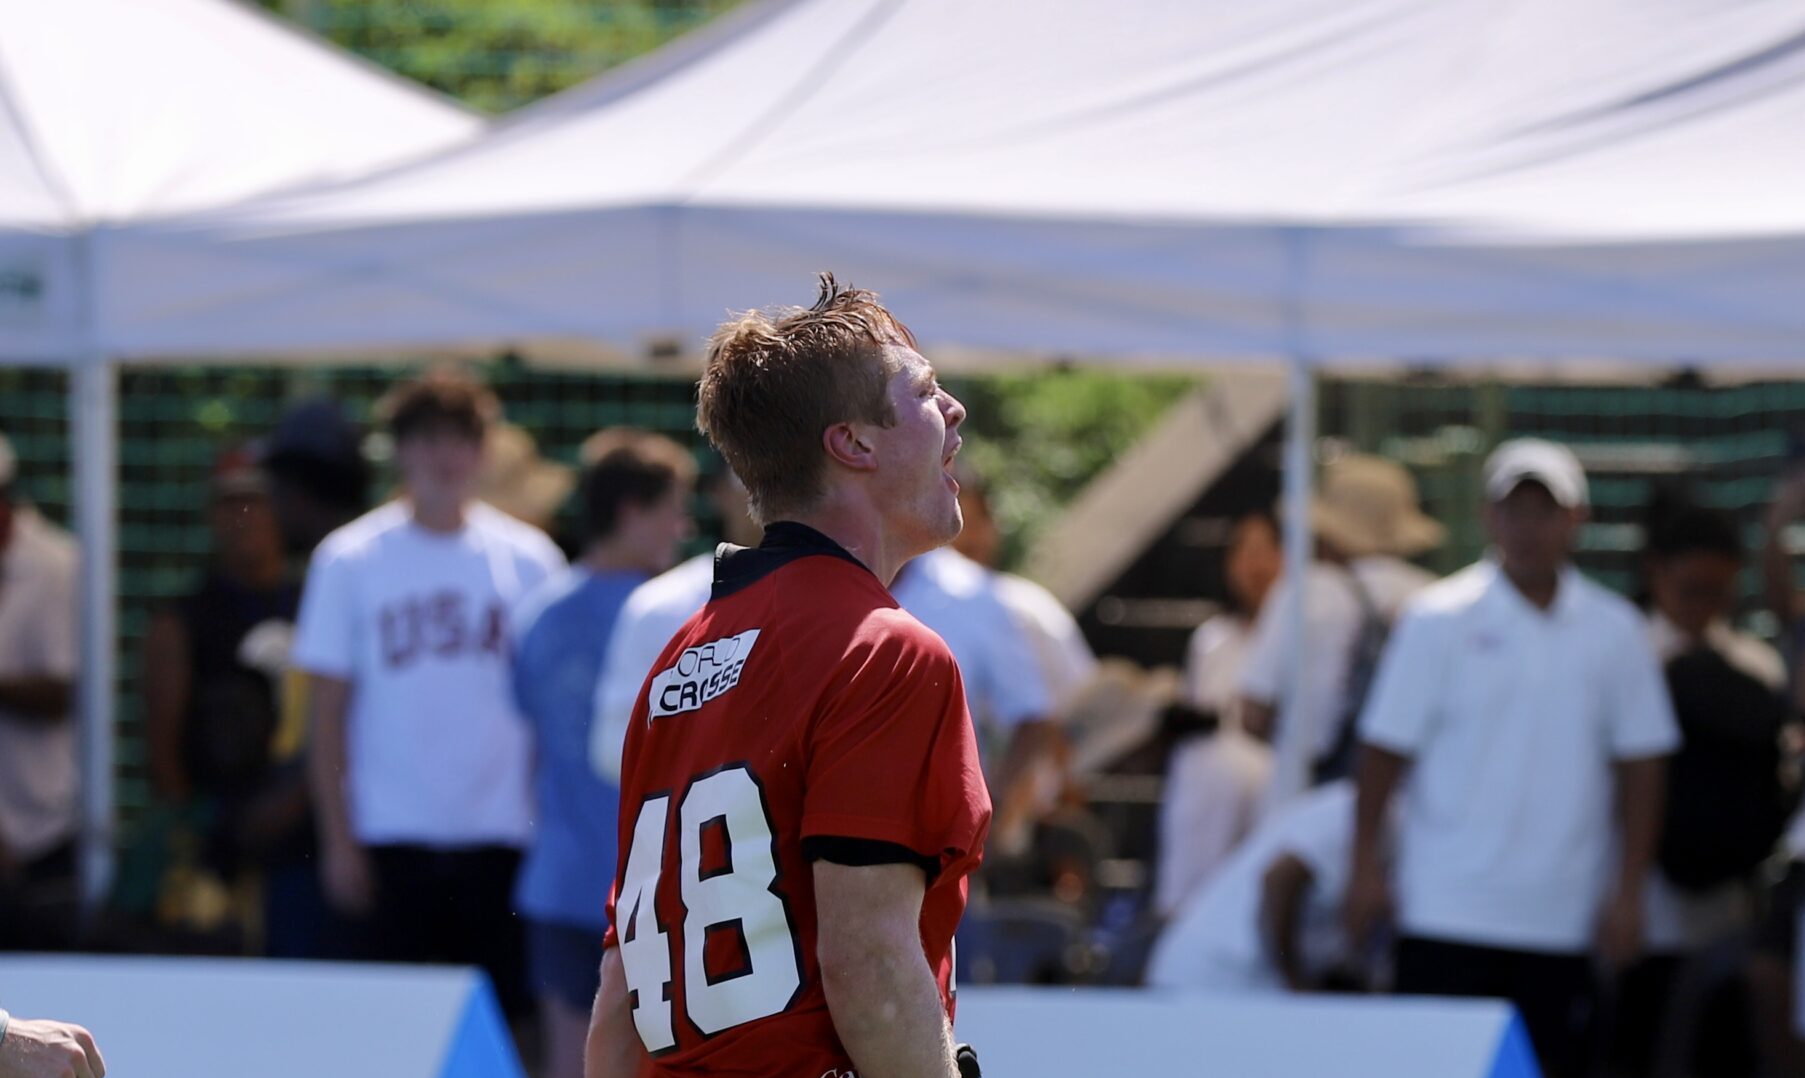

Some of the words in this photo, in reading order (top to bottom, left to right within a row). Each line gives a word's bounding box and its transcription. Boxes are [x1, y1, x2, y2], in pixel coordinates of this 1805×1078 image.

[379, 592, 511, 668] USA
[659, 658, 745, 711] CROSSE
[616, 766, 801, 1052] 48
